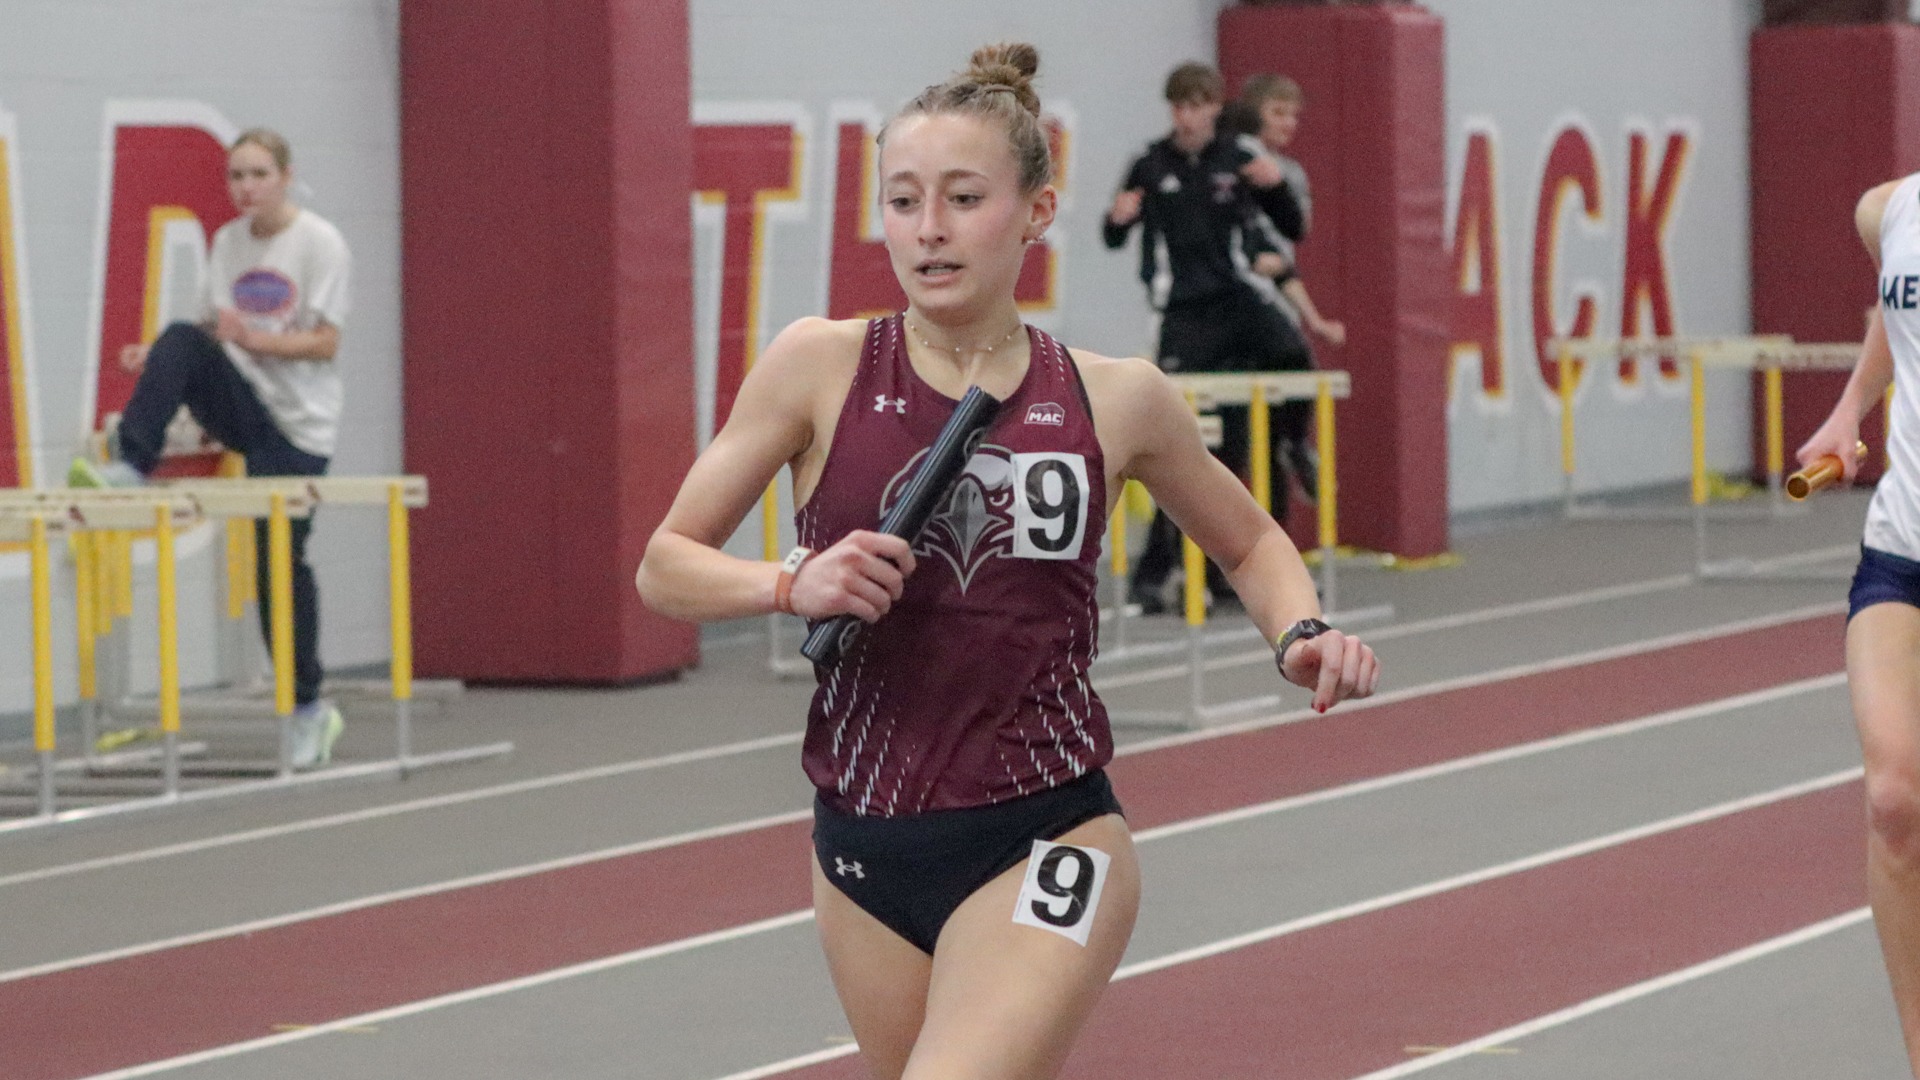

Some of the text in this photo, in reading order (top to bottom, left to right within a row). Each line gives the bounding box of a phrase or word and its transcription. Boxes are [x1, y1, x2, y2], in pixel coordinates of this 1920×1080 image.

[1028, 411, 1062, 424] MAC
[1025, 459, 1080, 552] 9
[1031, 845, 1095, 928] 9
